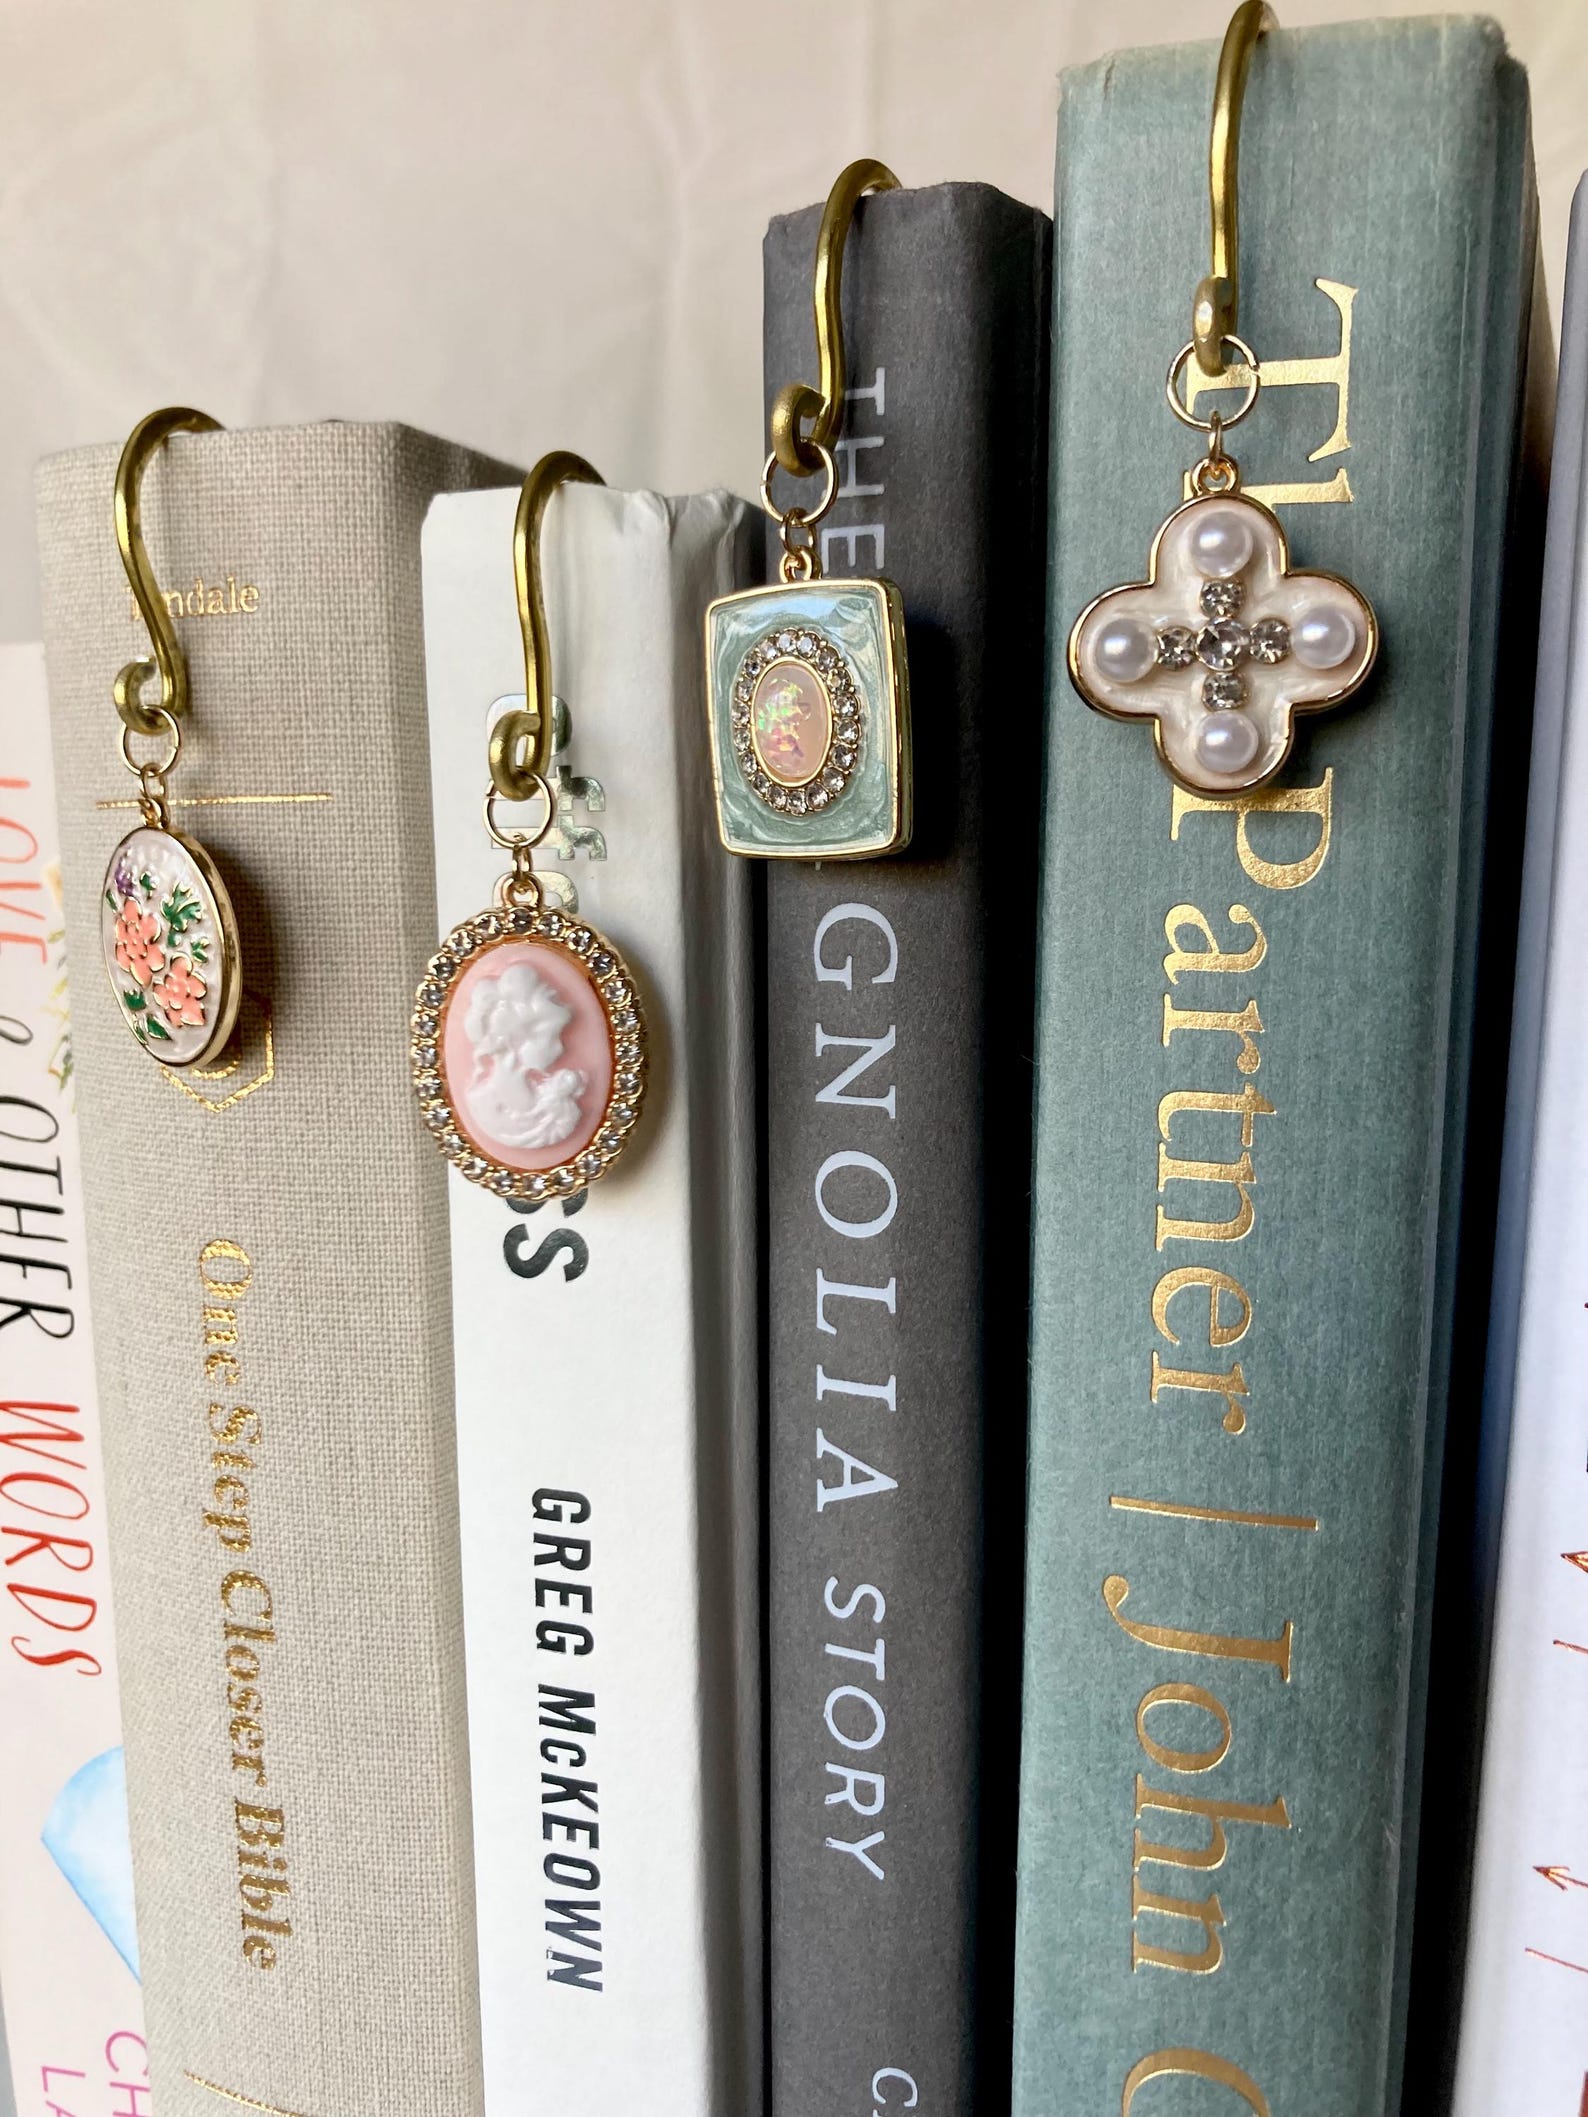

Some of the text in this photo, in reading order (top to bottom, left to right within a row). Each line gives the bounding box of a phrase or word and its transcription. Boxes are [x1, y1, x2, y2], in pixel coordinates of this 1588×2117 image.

[122, 575, 260, 622] ndale
[812, 366, 899, 1881] THE GNOLIA STORY
[1150, 766, 1334, 1436] Partner
[0, 1400, 103, 1677] WORDS
[199, 1238, 293, 1971] One Step Closer Bible
[531, 1486, 595, 1657] GREG
[1102, 1574, 1294, 1974] John
